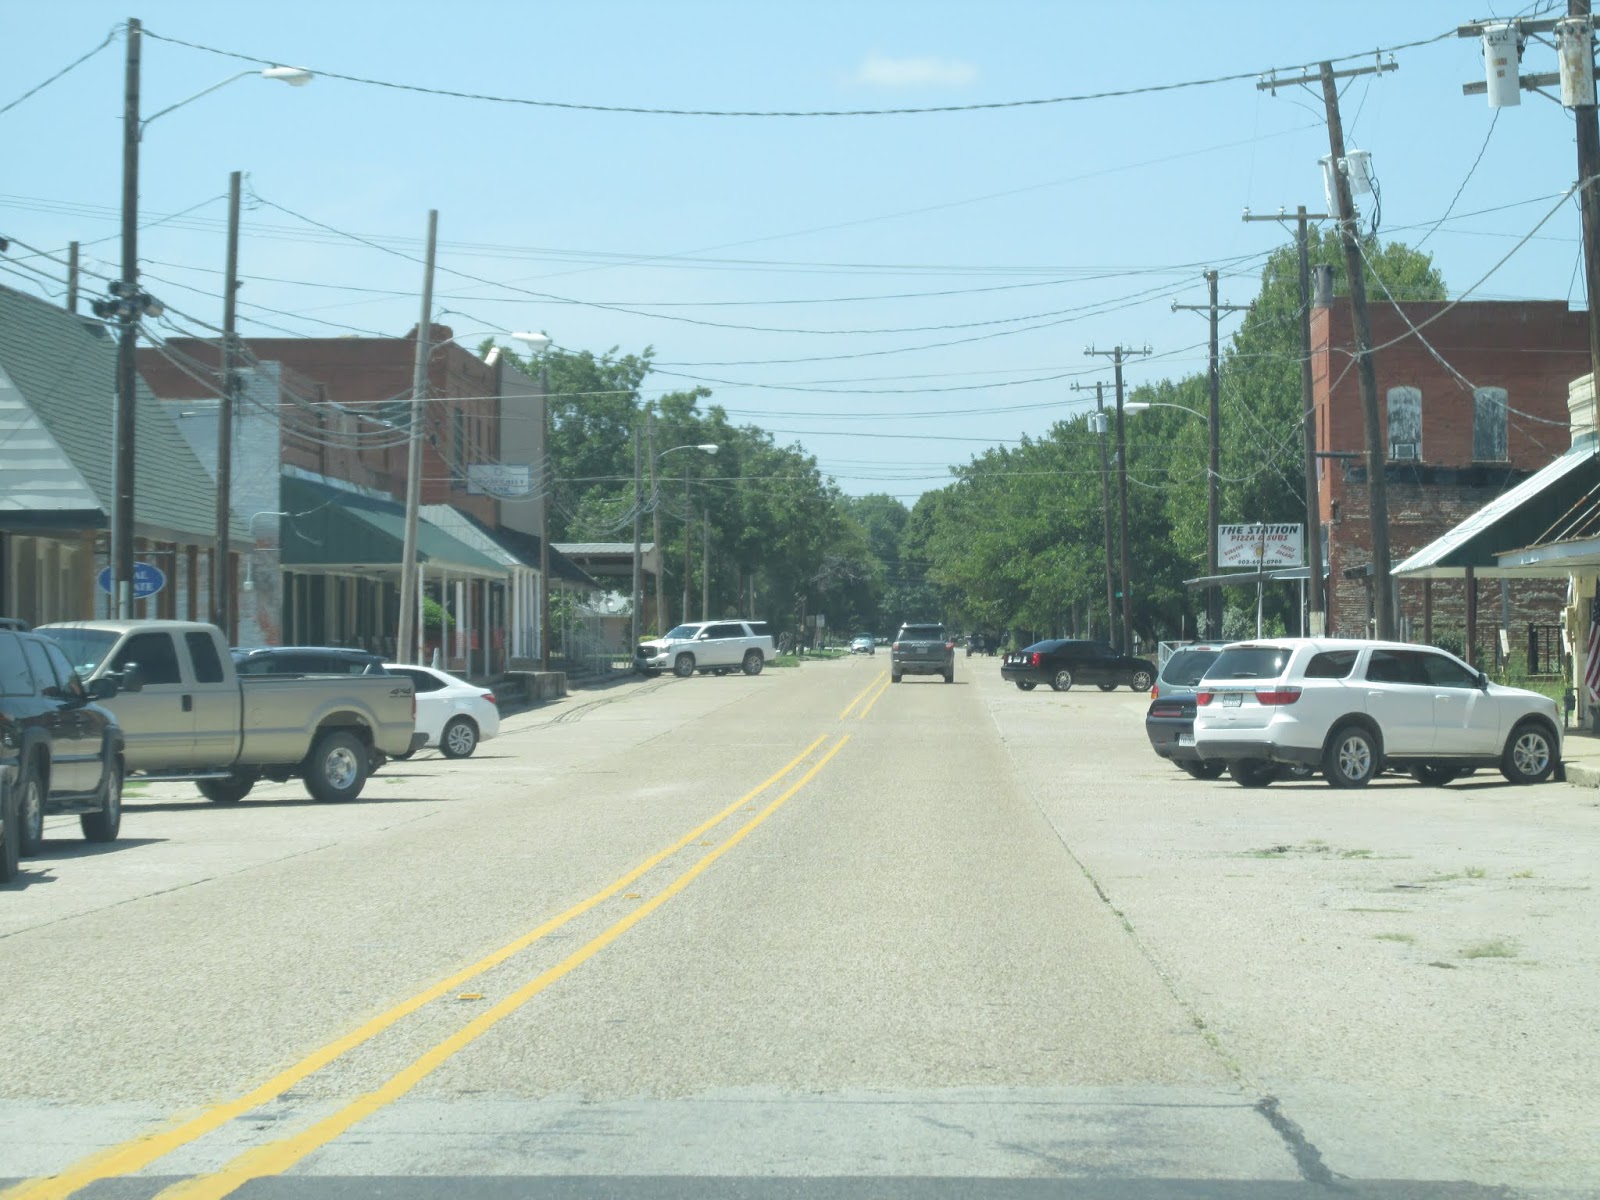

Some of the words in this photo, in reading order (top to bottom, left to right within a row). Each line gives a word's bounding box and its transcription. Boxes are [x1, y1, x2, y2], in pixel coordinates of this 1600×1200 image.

[1221, 526, 1243, 535] THE
[1248, 525, 1299, 534] STATION
[1224, 544, 1244, 556] BURGERS
[1280, 544, 1296, 553] TACOS
[1275, 550, 1295, 559] SALADS
